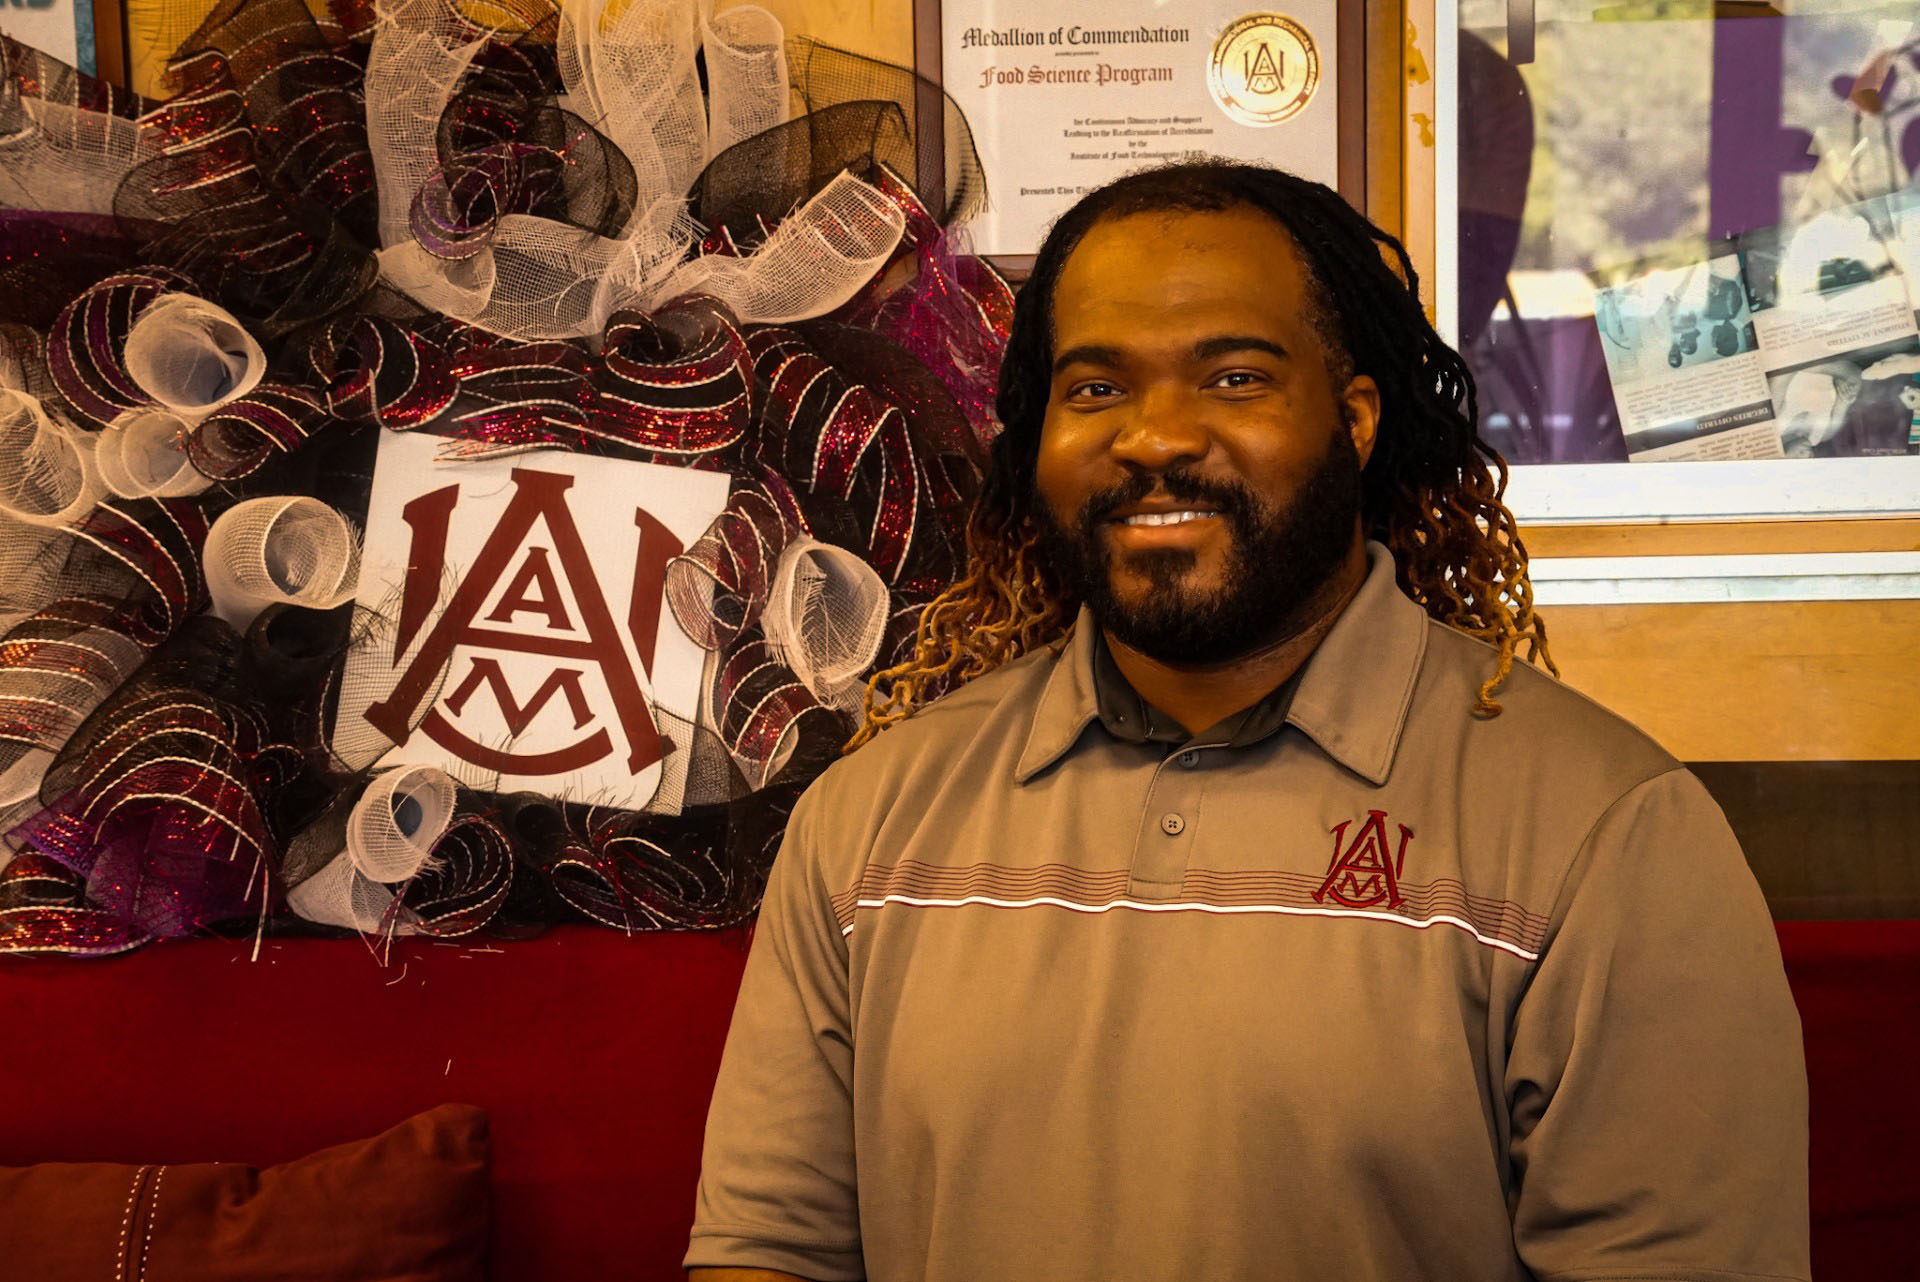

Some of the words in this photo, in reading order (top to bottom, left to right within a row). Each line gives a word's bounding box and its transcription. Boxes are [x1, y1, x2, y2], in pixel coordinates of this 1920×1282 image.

[961, 27, 1045, 48] Medallion
[1049, 27, 1064, 45] of
[1067, 26, 1190, 45] Commendation
[979, 66, 1024, 89] Food
[1027, 65, 1091, 84] Science
[1096, 63, 1173, 86] Program
[1020, 187, 1055, 196] Presented
